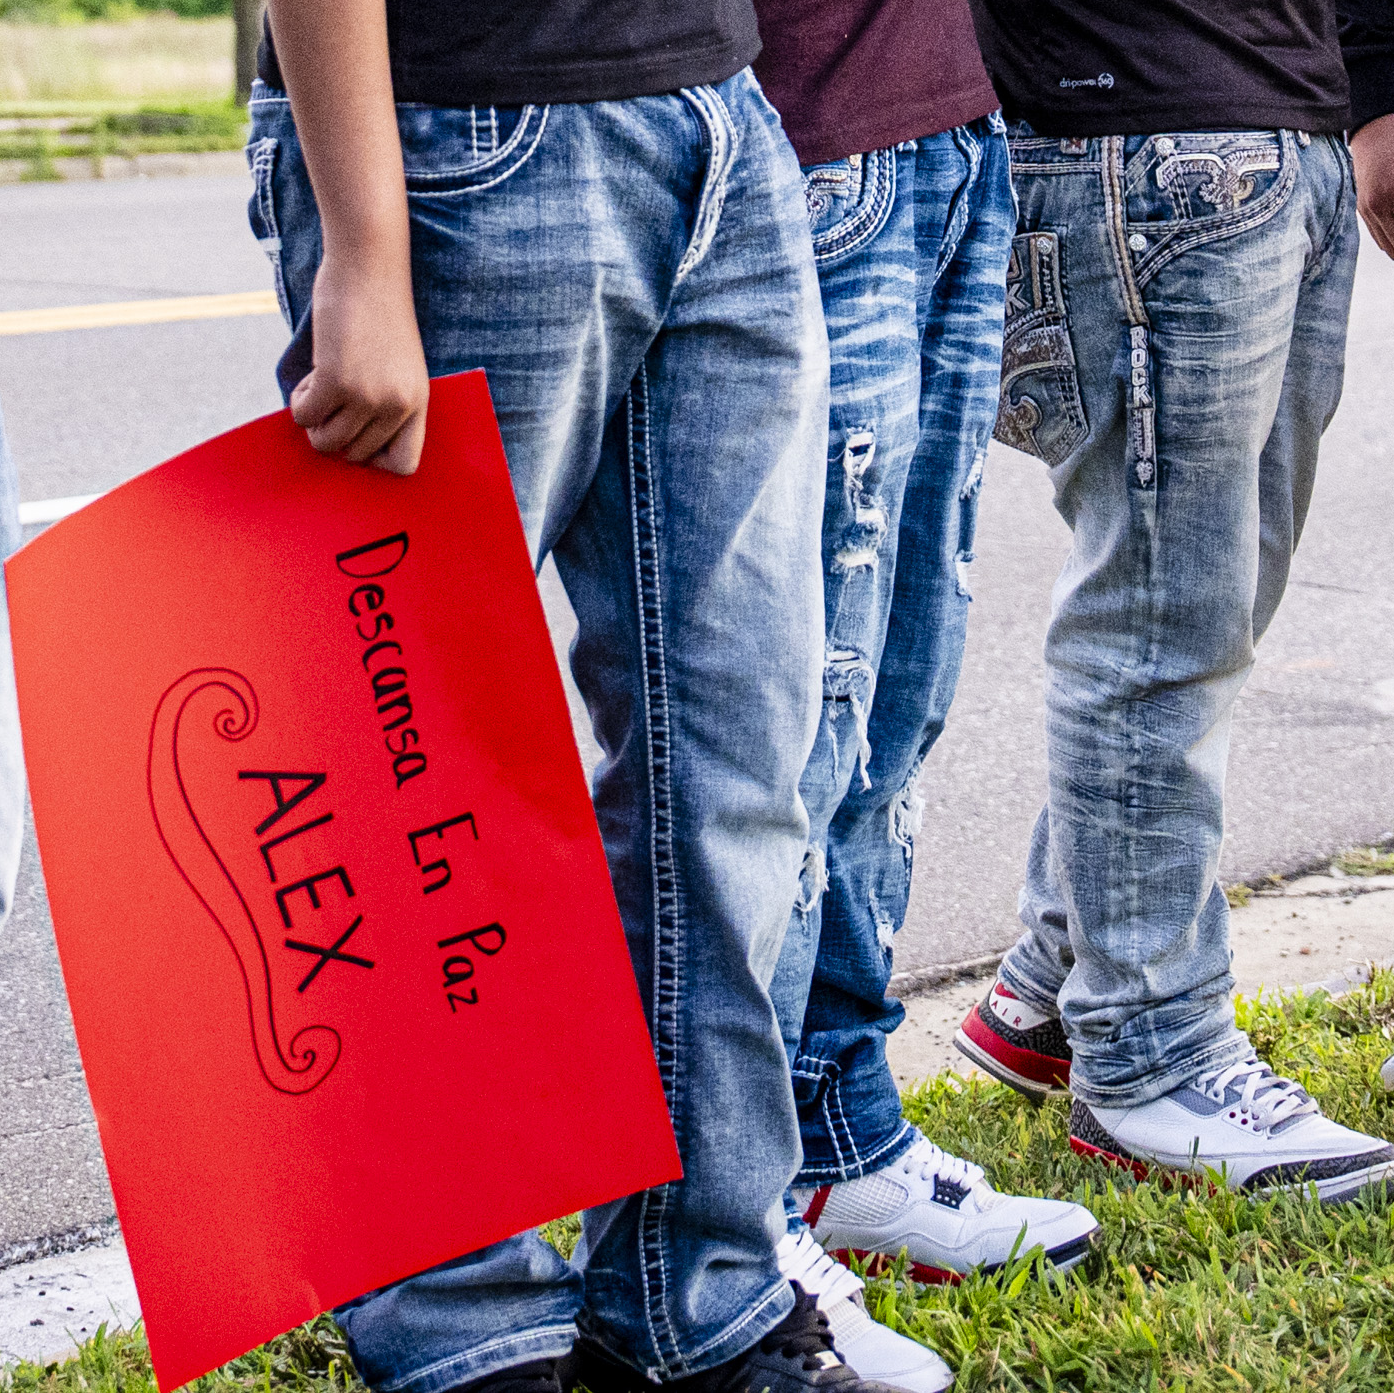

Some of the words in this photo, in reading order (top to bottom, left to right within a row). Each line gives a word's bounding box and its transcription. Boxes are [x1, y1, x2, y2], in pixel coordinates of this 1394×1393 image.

[1130, 325, 1152, 406] ROCK
[335, 530, 426, 790] Descansa
[239, 771, 375, 994] ALEX
[407, 811, 479, 895] En
[437, 922, 507, 1014] Paz
[991, 1000, 1022, 1027] AIR
